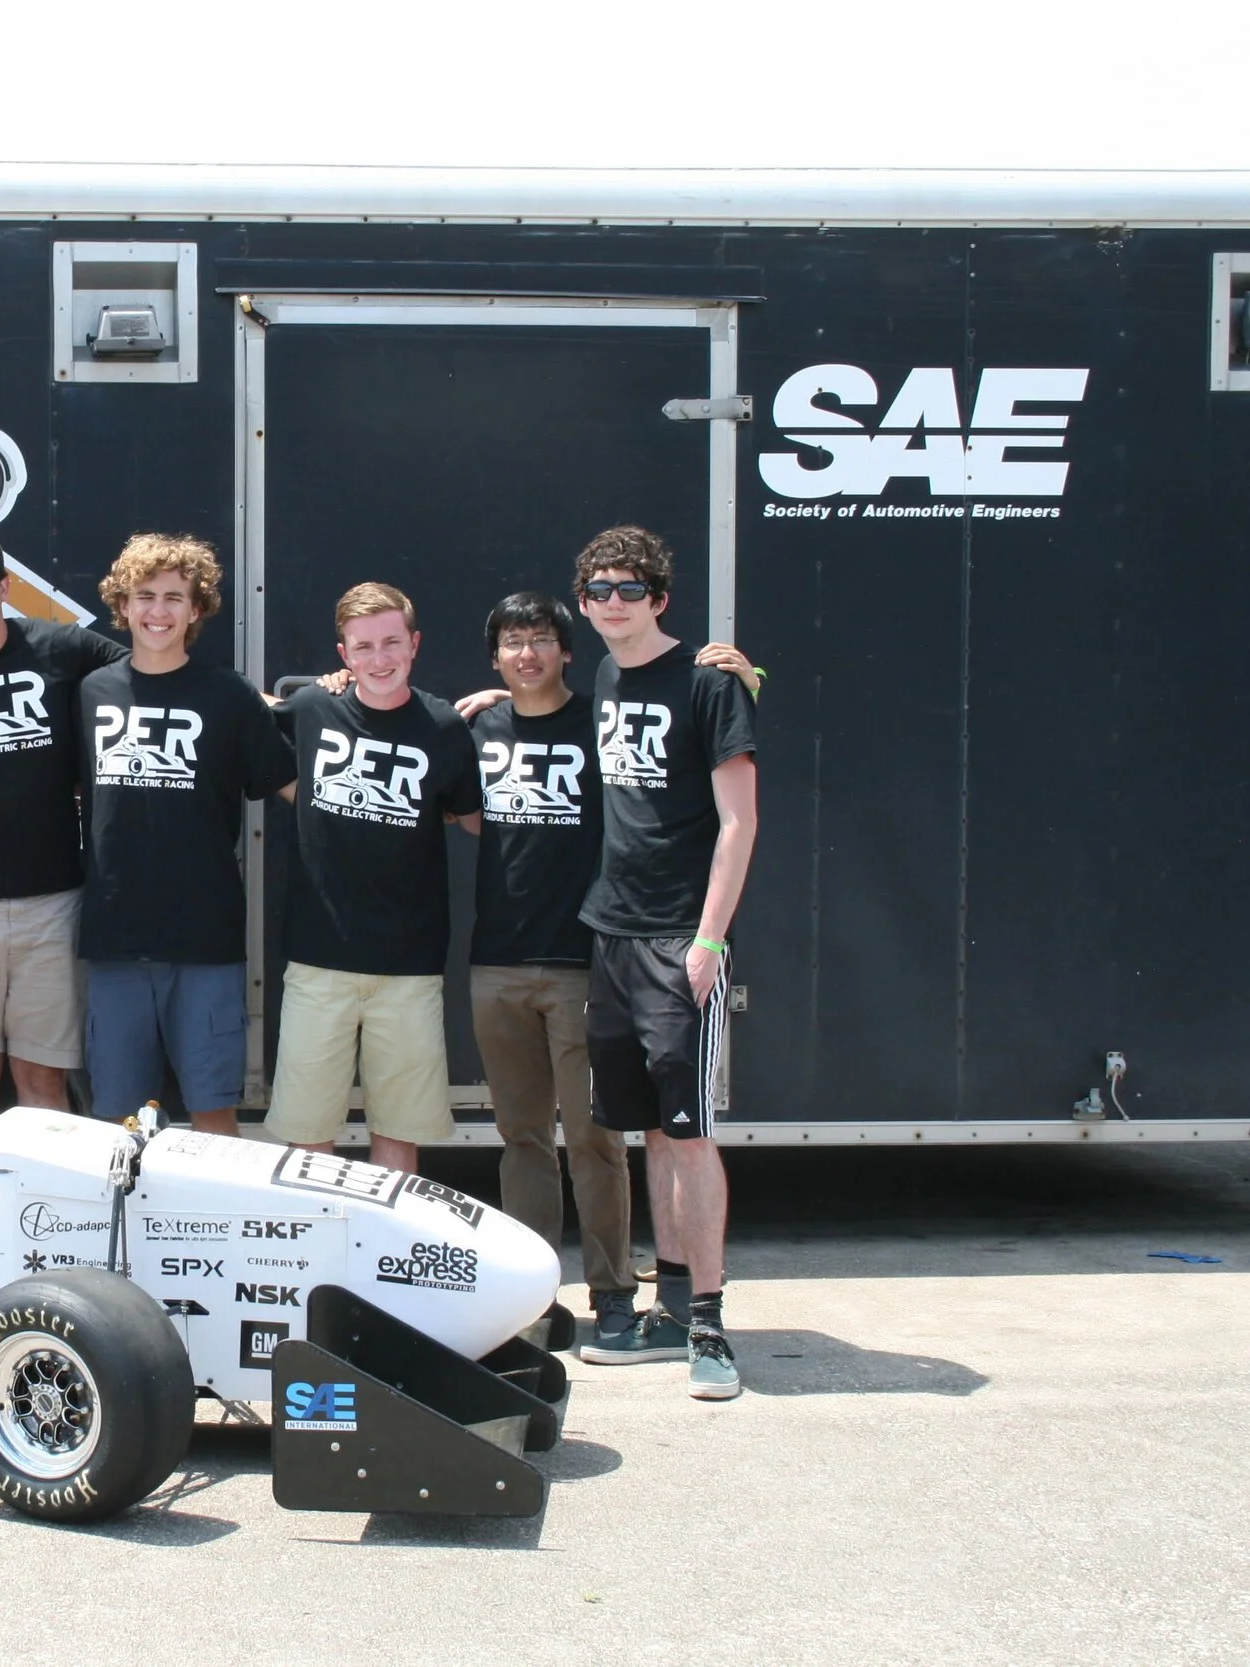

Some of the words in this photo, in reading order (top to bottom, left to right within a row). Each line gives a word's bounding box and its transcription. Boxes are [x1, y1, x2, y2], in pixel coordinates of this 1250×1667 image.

[758, 364, 1090, 499] SAE
[763, 504, 831, 520] Society
[837, 503, 857, 518] of
[862, 504, 965, 519] Automotive
[972, 504, 1061, 520] Engineers
[95, 705, 203, 761] PER
[597, 700, 672, 758] PER
[20, 737, 53, 750] RACING
[313, 728, 429, 800] PER
[479, 741, 585, 796] PER
[123, 777, 162, 787] ELECTRIC
[164, 779, 195, 789] RACING
[311, 798, 340, 814] PURDUE
[341, 807, 384, 822] ELECTRIC
[385, 815, 417, 827] RACING
[506, 814, 545, 825] ELECTRIC
[548, 816, 581, 825] RACING
[56, 1221, 111, 1233] CD-adapc
[142, 1217, 230, 1234] TeXtreme
[241, 1220, 313, 1240] SKF
[52, 1254, 75, 1265] VR3
[247, 1257, 295, 1268] CHERRY
[411, 1242, 478, 1267] estes
[161, 1258, 225, 1278] SPX
[377, 1255, 478, 1284] express
[235, 1282, 302, 1307] NSK
[412, 1279, 476, 1293] PROTOTYPING
[251, 1332, 279, 1354] GM
[285, 1382, 356, 1420] SAE
[285, 1422, 356, 1430] INTERNATIONAL
